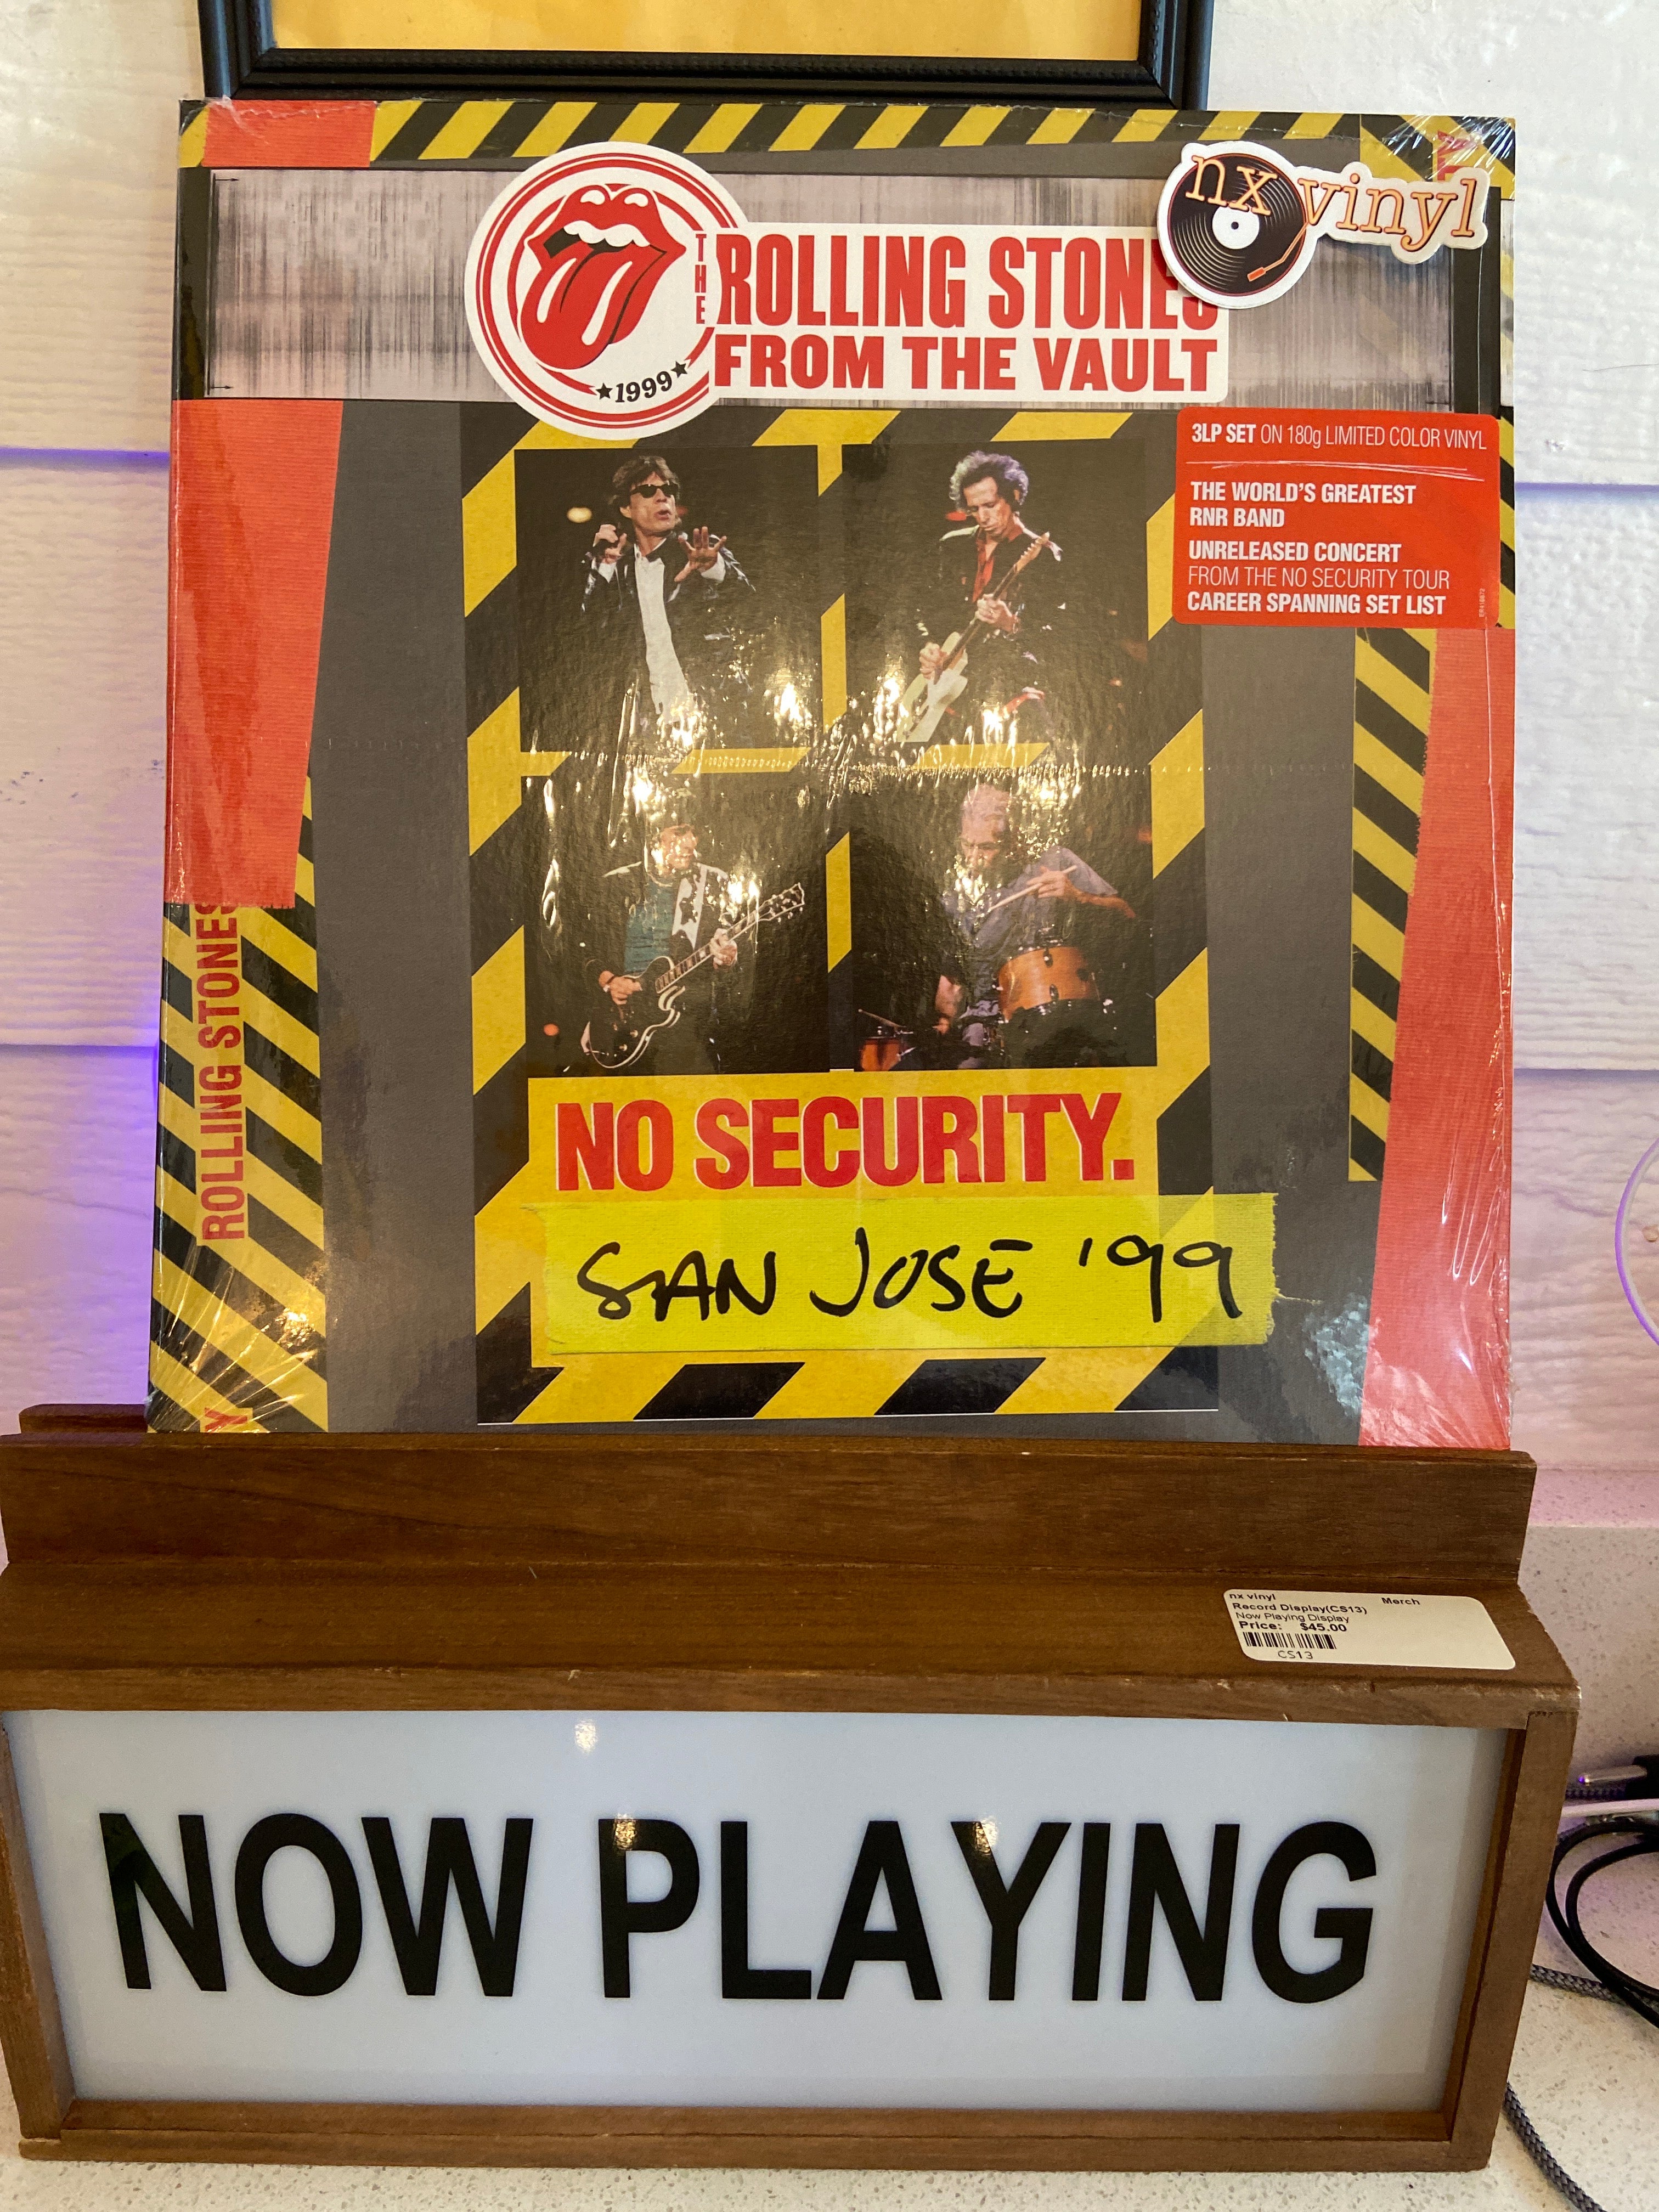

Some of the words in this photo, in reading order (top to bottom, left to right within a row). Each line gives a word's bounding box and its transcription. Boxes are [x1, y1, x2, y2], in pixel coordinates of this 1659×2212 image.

[1185, 154, 1279, 216] nx
[1297, 172, 1477, 252] vinyl
[695, 233, 707, 324] THE
[715, 234, 966, 328] ROLLING
[714, 334, 884, 389] FROM
[902, 336, 1017, 390] THE
[1032, 337, 1217, 392] VAULT
[614, 370, 672, 403] 1999
[1191, 423, 1222, 443] 3LP
[1225, 424, 1256, 444] SET
[1260, 424, 1283, 445] ON
[1286, 424, 1322, 449] 180g
[1325, 425, 1386, 447] LIMITED
[1389, 427, 1440, 448] COLOR
[1445, 428, 1487, 450] VINYL
[1190, 481, 1226, 501] THE
[1232, 482, 1316, 504] WORLD'S
[1321, 483, 1417, 505] GREATEST
[1189, 507, 1228, 527] RNR
[1233, 508, 1285, 528] BAND
[1188, 540, 1308, 562] UNRELEASED
[1313, 541, 1402, 563] CONCERT
[1188, 565, 1239, 586] FROM
[1244, 566, 1277, 587] THE
[1282, 567, 1307, 588] NO
[1312, 567, 1402, 589] SECURITY
[1402, 569, 1450, 590] TOUR
[1187, 590, 1264, 612] CAREER
[1266, 592, 1361, 614] SPANNING
[1365, 594, 1401, 615] SET
[1405, 595, 1447, 616] LIST
[200, 1064, 245, 1240] ROLLING
[556, 1101, 674, 1192] NO
[693, 1092, 1135, 1189] SECURITY.
[576, 1241, 777, 1323] SAN
[810, 1226, 1034, 1319] JOSE
[1079, 1234, 1243, 1323] '99
[1247, 1593, 1276, 1601] vinyl
[1280, 1604, 1367, 1615] Display(CS13)
[1239, 1621, 1282, 1630] Price:
[1300, 1623, 1347, 1632] $45.00
[1264, 1613, 1305, 1622] Playing
[1308, 1614, 1349, 1623] Display
[1278, 1650, 1313, 1660] CS13
[99, 1812, 534, 1997] NOW
[599, 1818, 1378, 2004] PLAYING
